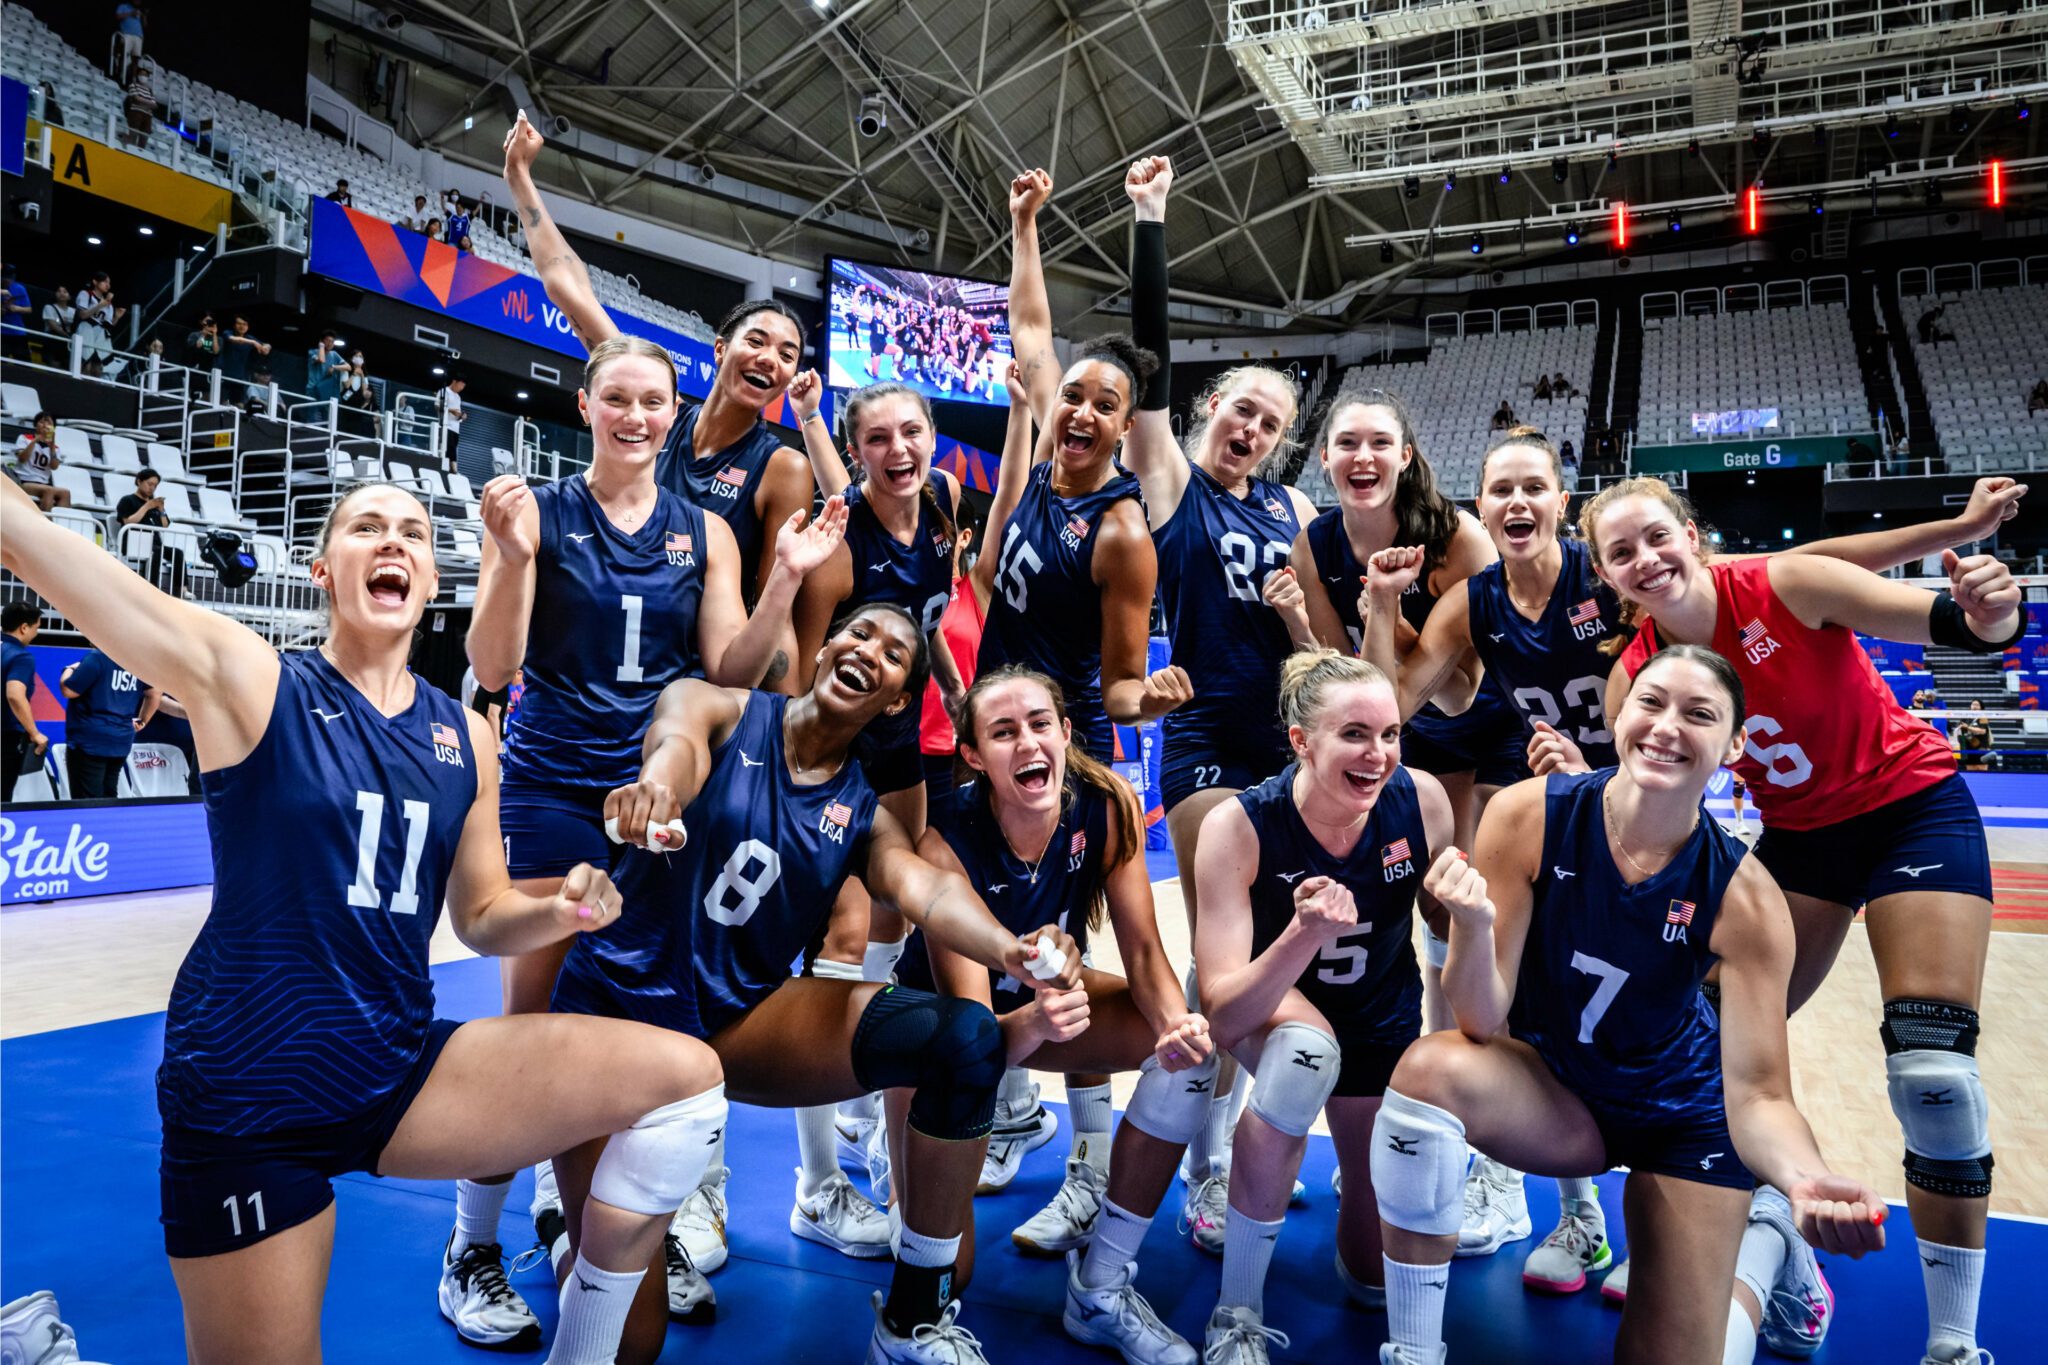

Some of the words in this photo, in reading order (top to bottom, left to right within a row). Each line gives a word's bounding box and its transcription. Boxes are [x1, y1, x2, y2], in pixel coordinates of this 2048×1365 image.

[64, 143, 91, 186] A
[501, 289, 535, 324] VNL
[667, 349, 692, 367] ATIONS
[34, 452, 49, 467] 10
[1723, 452, 1760, 467] Gate
[1765, 444, 1781, 465] G
[710, 479, 740, 500] USA
[1271, 509, 1292, 523] USA
[935, 538, 952, 558] USA
[1059, 526, 1081, 552] USA
[667, 551, 695, 567] USA
[994, 522, 1043, 614] 15
[616, 594, 644, 683] 1
[1573, 618, 1607, 641] USA
[1745, 636, 1782, 665] USA
[111, 669, 137, 691] USA
[434, 743, 464, 768] USA
[1744, 714, 1813, 788] 6
[1194, 765, 1222, 788] 22
[819, 815, 843, 844] USA
[347, 790, 429, 915] 11
[703, 838, 781, 926] 8
[1383, 859, 1415, 883] USA
[14, 879, 69, 899] .com
[1662, 923, 1688, 945] UA
[1317, 921, 1373, 984] 5
[1570, 950, 1631, 1044] 7
[223, 1190, 266, 1236] 11
